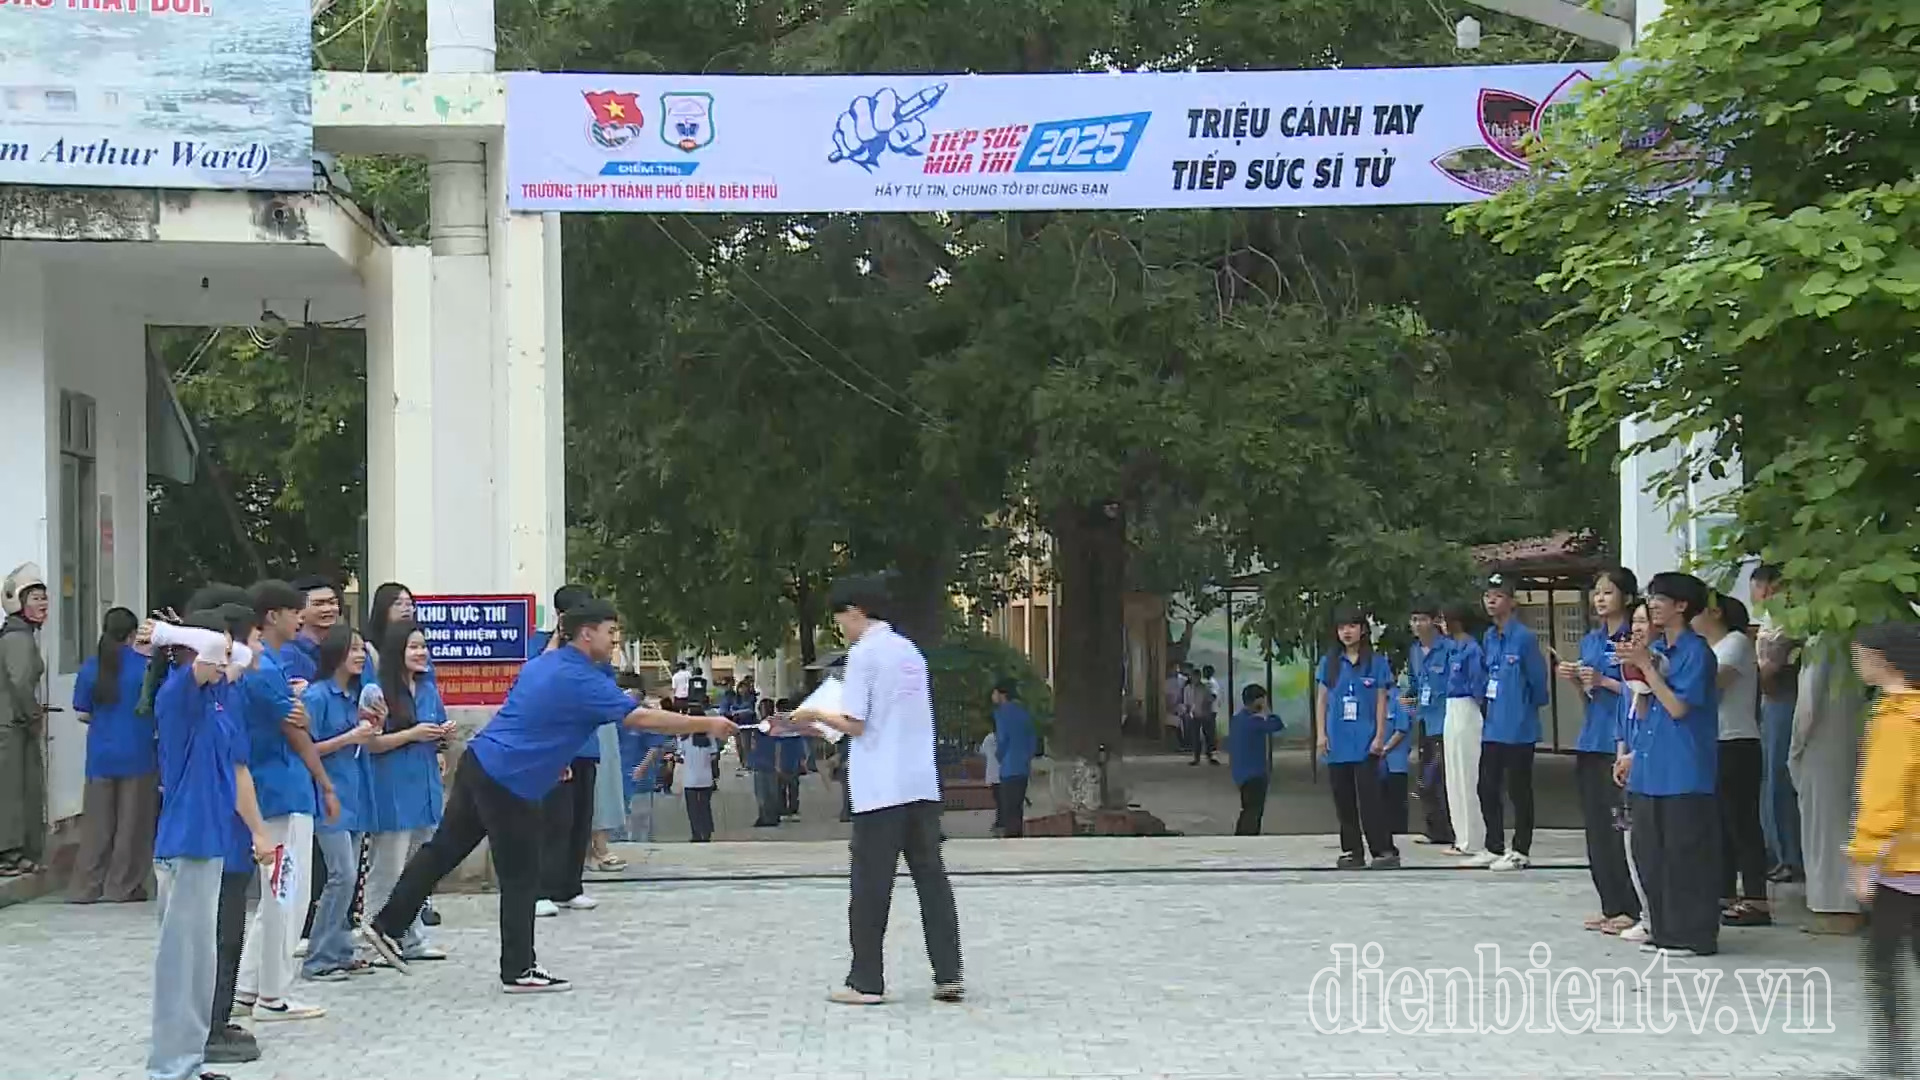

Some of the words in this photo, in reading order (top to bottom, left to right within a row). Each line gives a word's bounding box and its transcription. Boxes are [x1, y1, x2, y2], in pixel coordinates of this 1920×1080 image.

[1187, 101, 1270, 146] TRIỆU
[1280, 100, 1363, 137] CÁNH
[1373, 104, 1425, 136] TAY
[1028, 119, 1134, 167] 2025
[40, 135, 159, 165] Arthur
[172, 140, 271, 175] Ward)
[978, 151, 1017, 173] THI
[1172, 149, 1238, 190] TIẾP
[1245, 152, 1306, 190] SỨC
[1313, 152, 1345, 189] SĨ
[1355, 148, 1396, 188] TỬ
[576, 184, 607, 198] THPT
[611, 181, 653, 199] THÀNH
[417, 606, 447, 623] KHU
[450, 604, 480, 625] VỰC
[484, 605, 508, 623] THI
[424, 629, 451, 641] ÔNG
[454, 627, 497, 642] NHIỆM
[501, 629, 518, 642] VỤ
[432, 643, 463, 657] CẤM
[465, 645, 492, 657] VÀO
